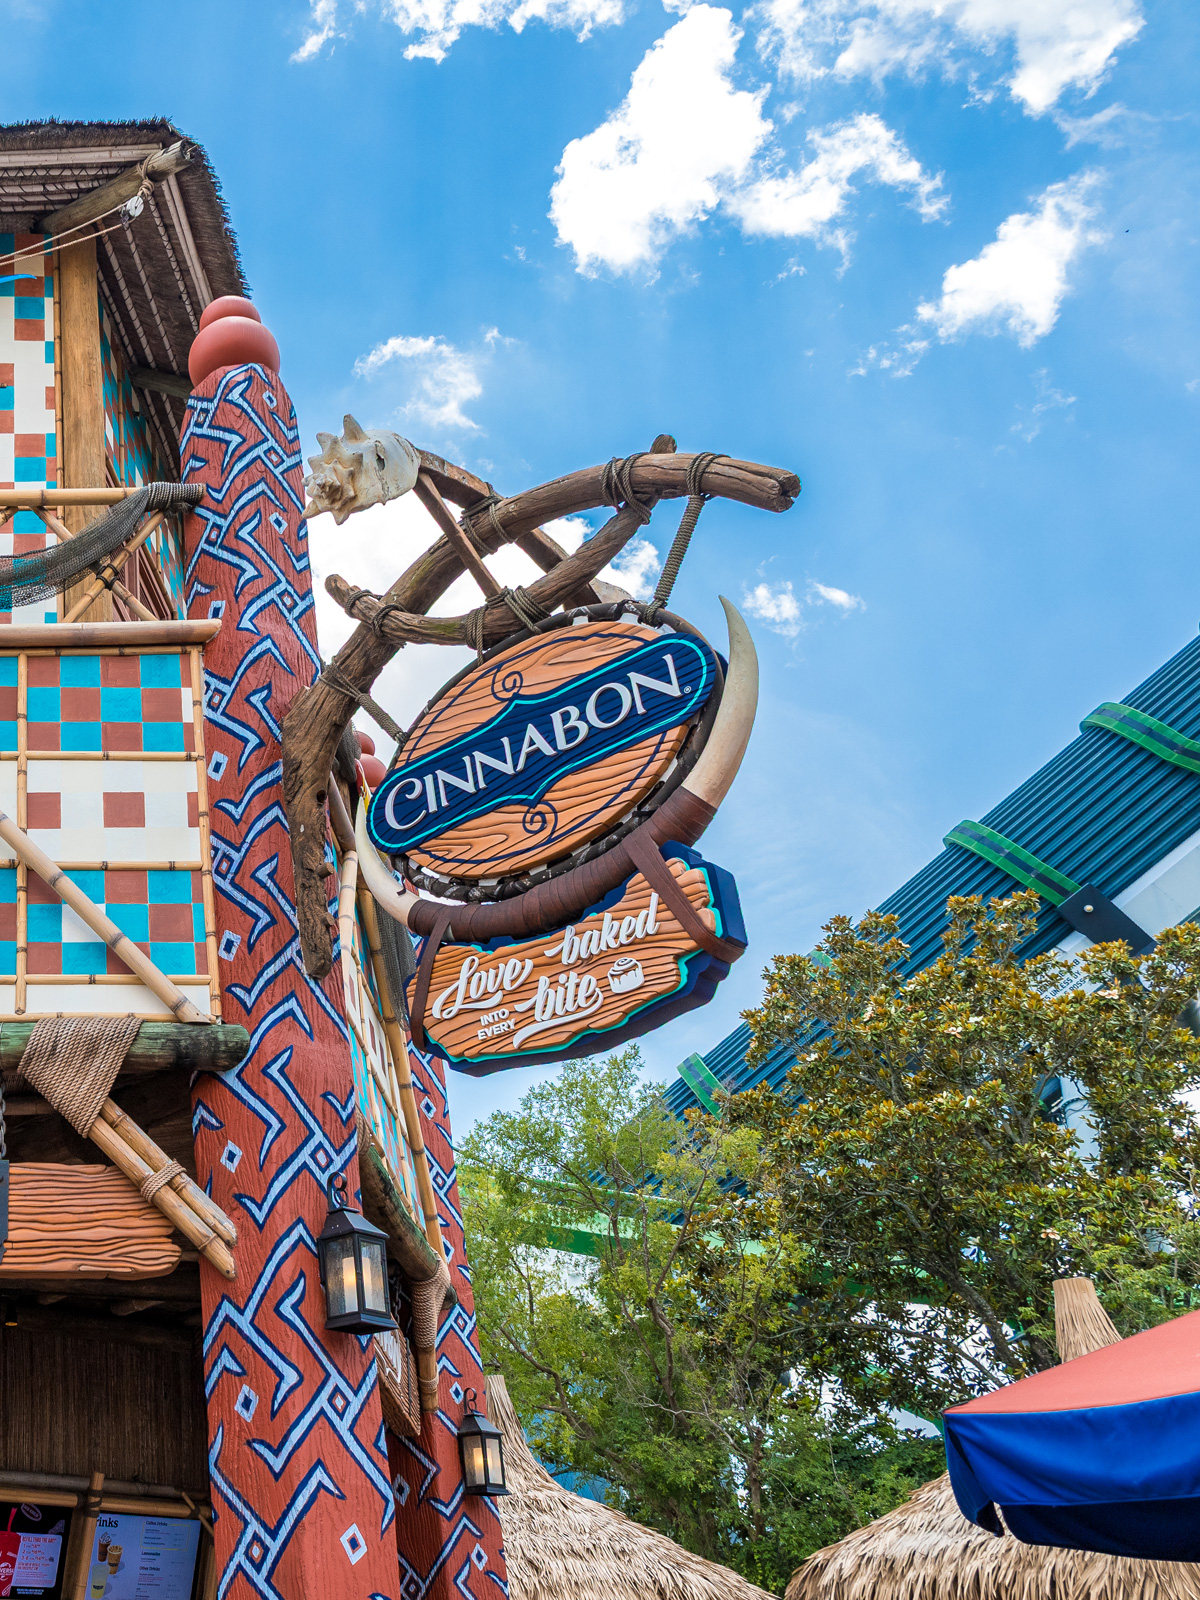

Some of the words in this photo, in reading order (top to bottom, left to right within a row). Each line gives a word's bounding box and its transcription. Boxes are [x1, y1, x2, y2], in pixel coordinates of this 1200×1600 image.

[385, 654, 682, 830] CINNABON
[432, 956, 533, 1020] Love
[544, 892, 659, 966] baked
[477, 1018, 516, 1040] EVERY
[480, 1008, 509, 1025] INTO
[514, 971, 604, 1048] bite
[96, 1517, 119, 1528] rinks
